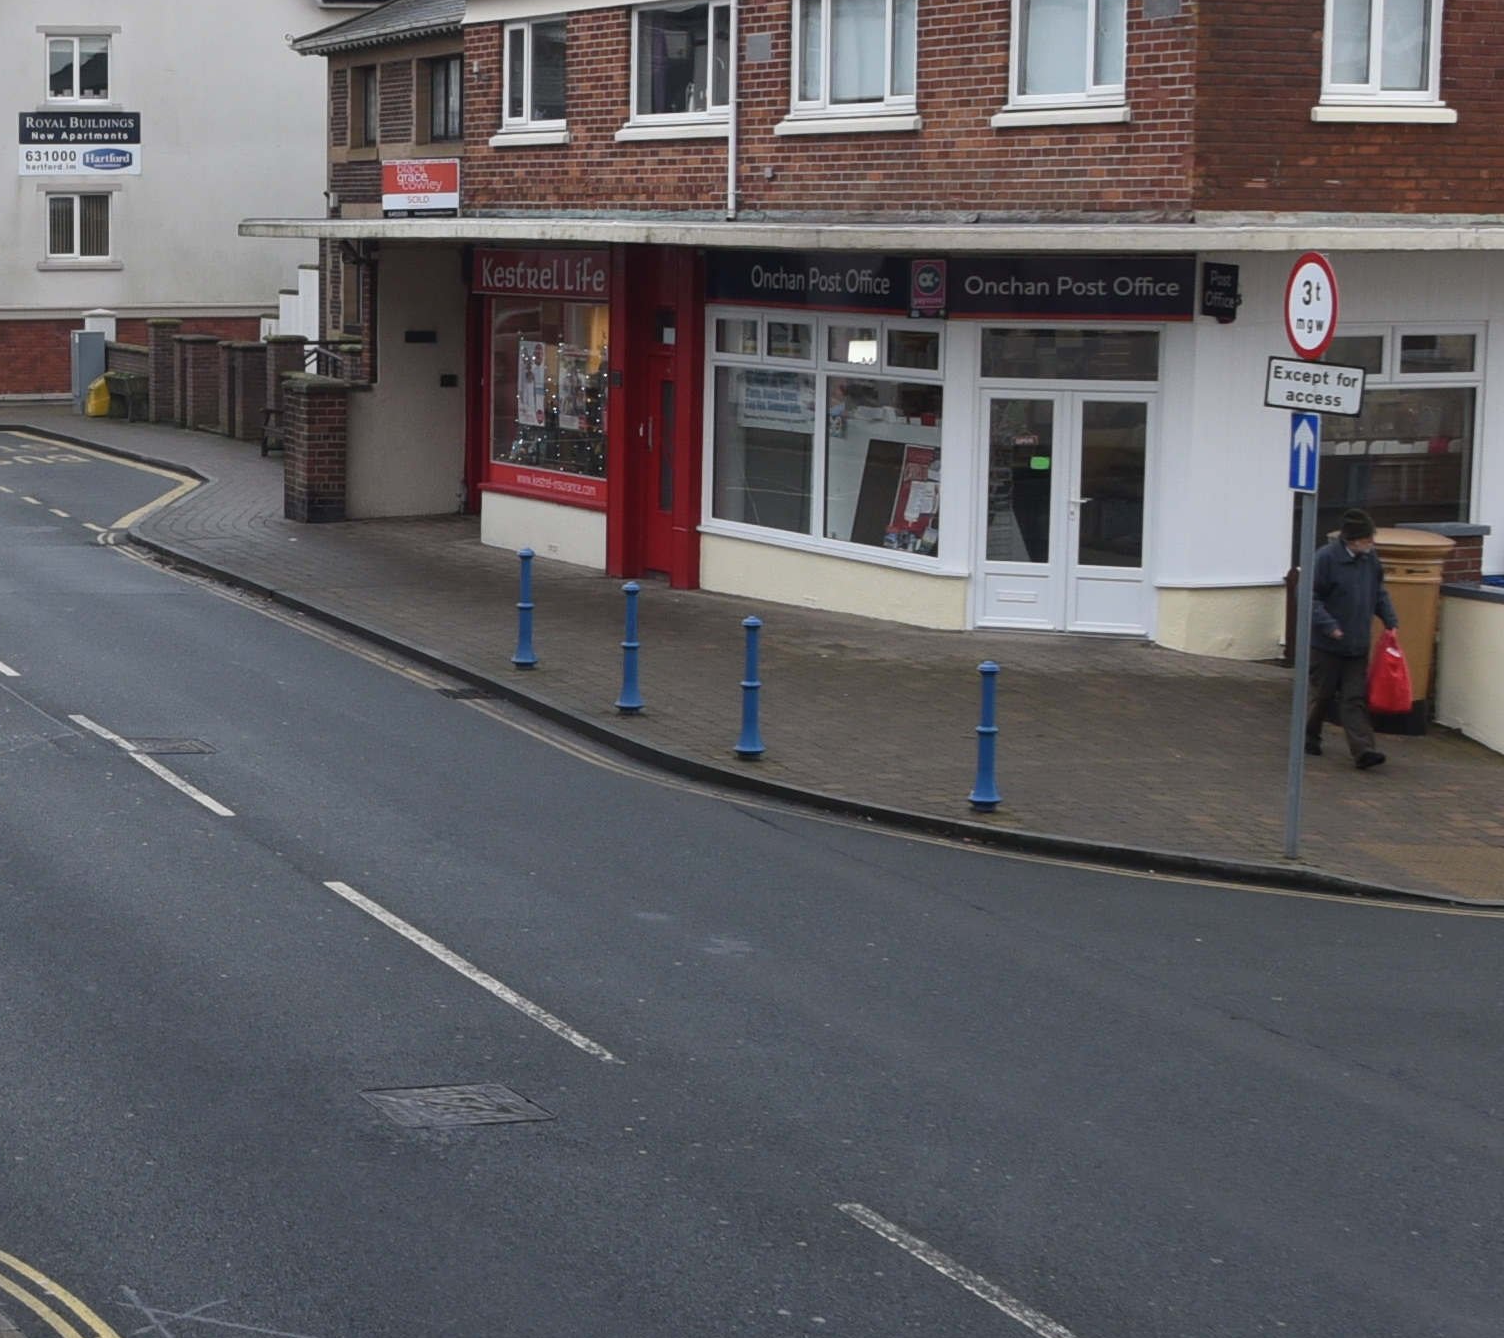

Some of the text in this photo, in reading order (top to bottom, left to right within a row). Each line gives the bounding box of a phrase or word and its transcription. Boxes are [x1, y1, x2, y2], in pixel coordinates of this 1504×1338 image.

[26, 116, 134, 128] ROYAL BUILDINGS
[32, 132, 128, 141] New Apartments
[26, 151, 130, 164] 631000 Hartford
[397, 173, 428, 184] grace
[402, 181, 442, 192] cowley
[407, 196, 430, 204] SOLD
[564, 258, 605, 291] Life
[751, 265, 890, 294] Onchan Post Office
[1210, 270, 1232, 287] Post
[964, 276, 1180, 296] Onchan Post Office
[1204, 291, 1235, 308] Office
[1273, 365, 1359, 388] Except for
[1285, 390, 1342, 407] access
